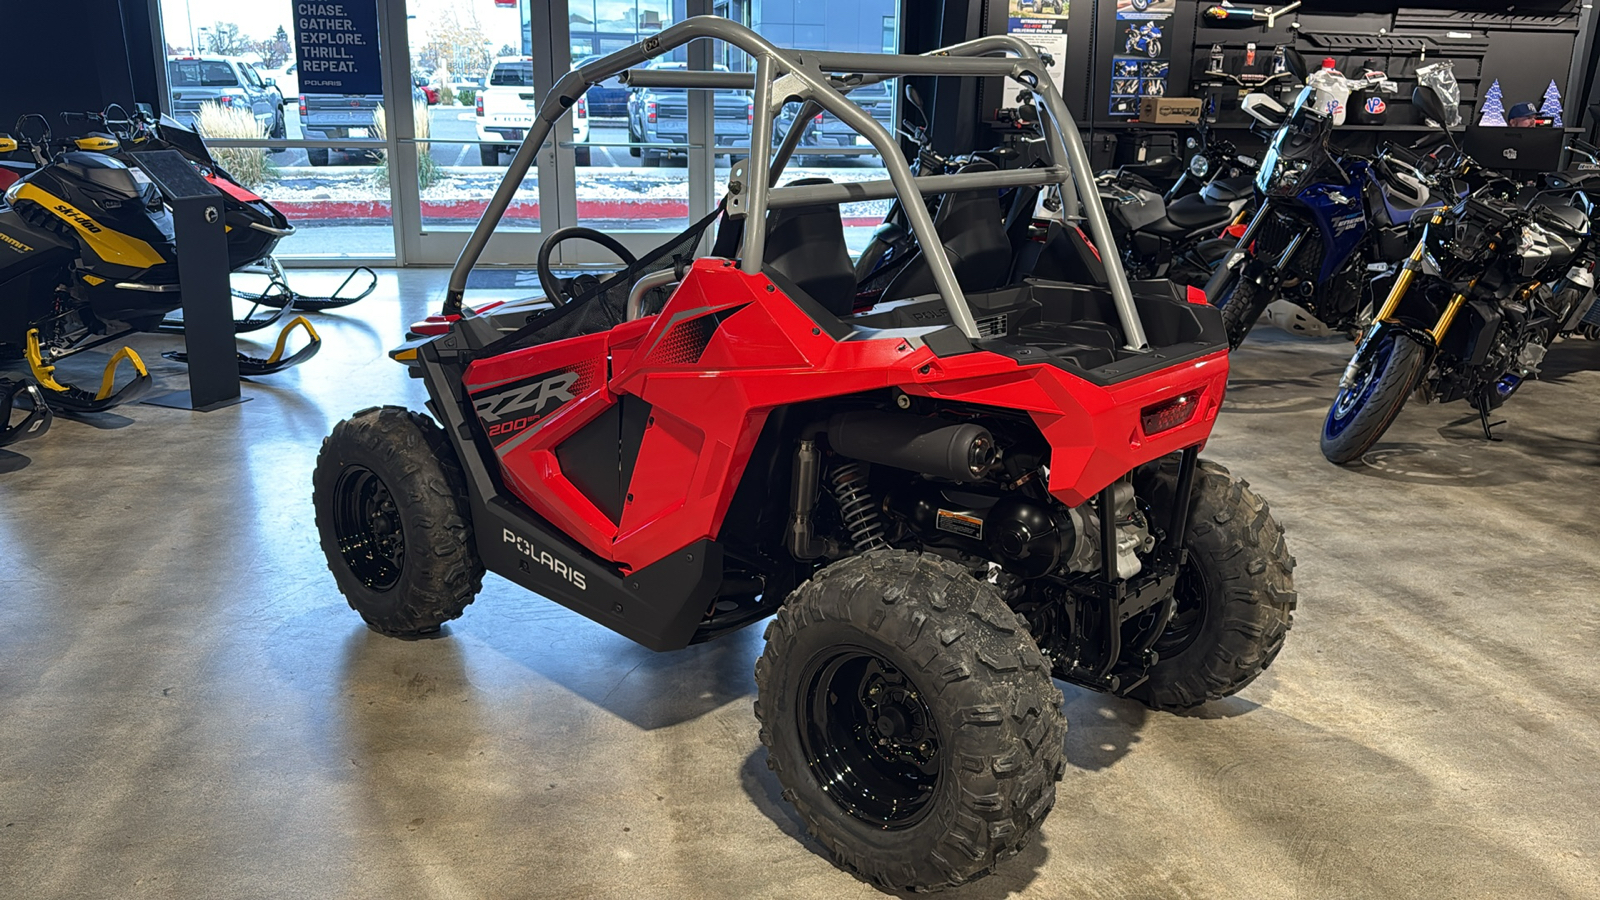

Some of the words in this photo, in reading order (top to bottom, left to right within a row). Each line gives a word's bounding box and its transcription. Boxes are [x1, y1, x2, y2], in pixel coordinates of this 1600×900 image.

[298, 4, 347, 16] CHASE.
[299, 18, 356, 31] GATHER.
[300, 32, 366, 45] EXPLORE.
[301, 46, 353, 59] THRILL.
[303, 60, 358, 73] REPEAT.
[53, 203, 102, 234] ski-doo
[913, 308, 948, 321] POLA
[473, 371, 580, 423] RZR
[503, 527, 587, 591] POLARIS
